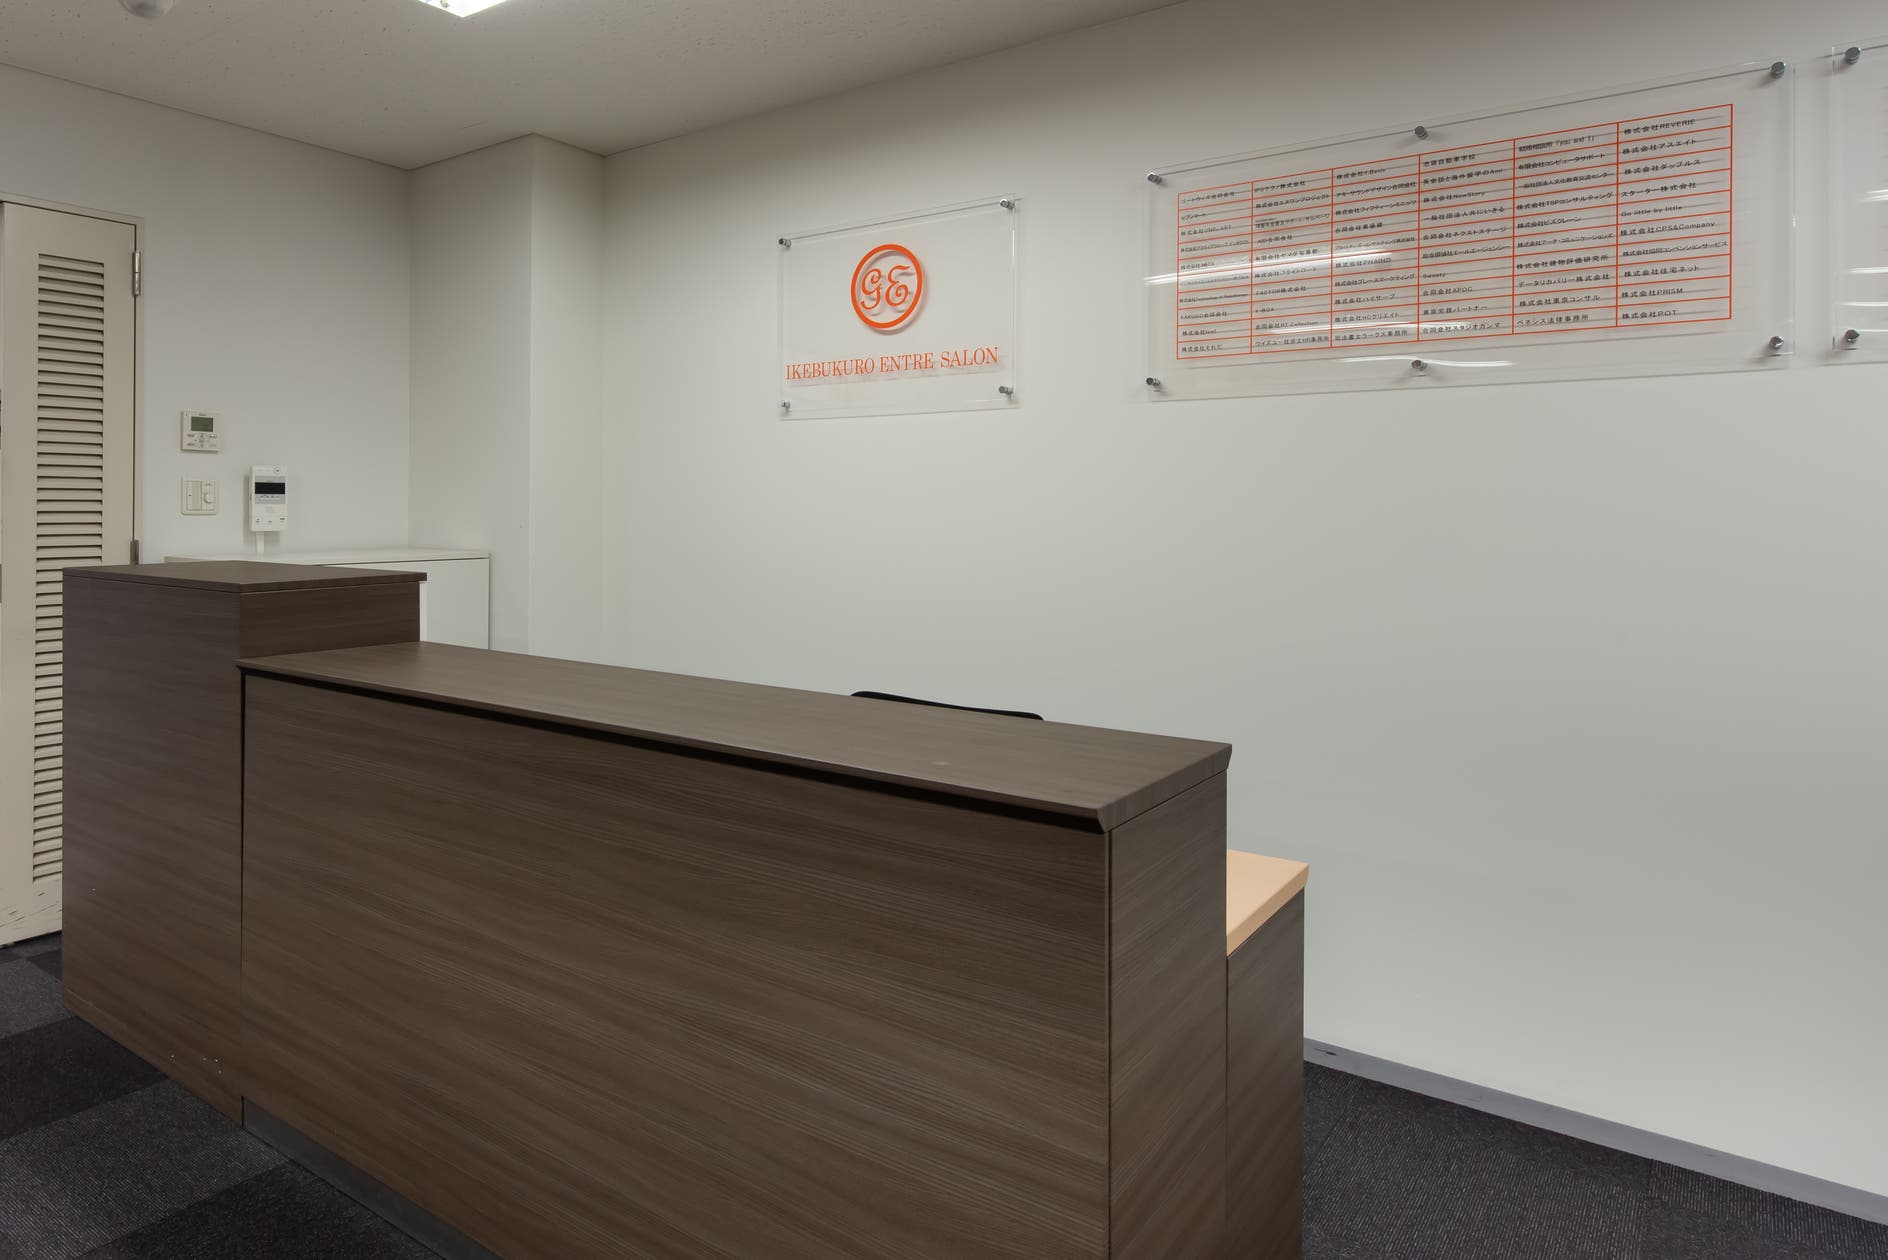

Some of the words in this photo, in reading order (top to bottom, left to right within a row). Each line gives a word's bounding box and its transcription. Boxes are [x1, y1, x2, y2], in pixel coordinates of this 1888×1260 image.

[1623, 118, 1697, 135] 株式会社REVERIE
[1622, 138, 1697, 155] 株式会社アスエイト
[1620, 181, 1697, 198] スターター株式会社
[1624, 264, 1699, 278] 株式会社住宅ネット
[1519, 294, 1600, 307] 株式会社東京コンサル
[1621, 287, 1684, 299] 株式会社PRISM
[786, 358, 875, 380] IKEBUKURO
[879, 352, 934, 373] ENTRE
[940, 346, 1000, 368] SALON
